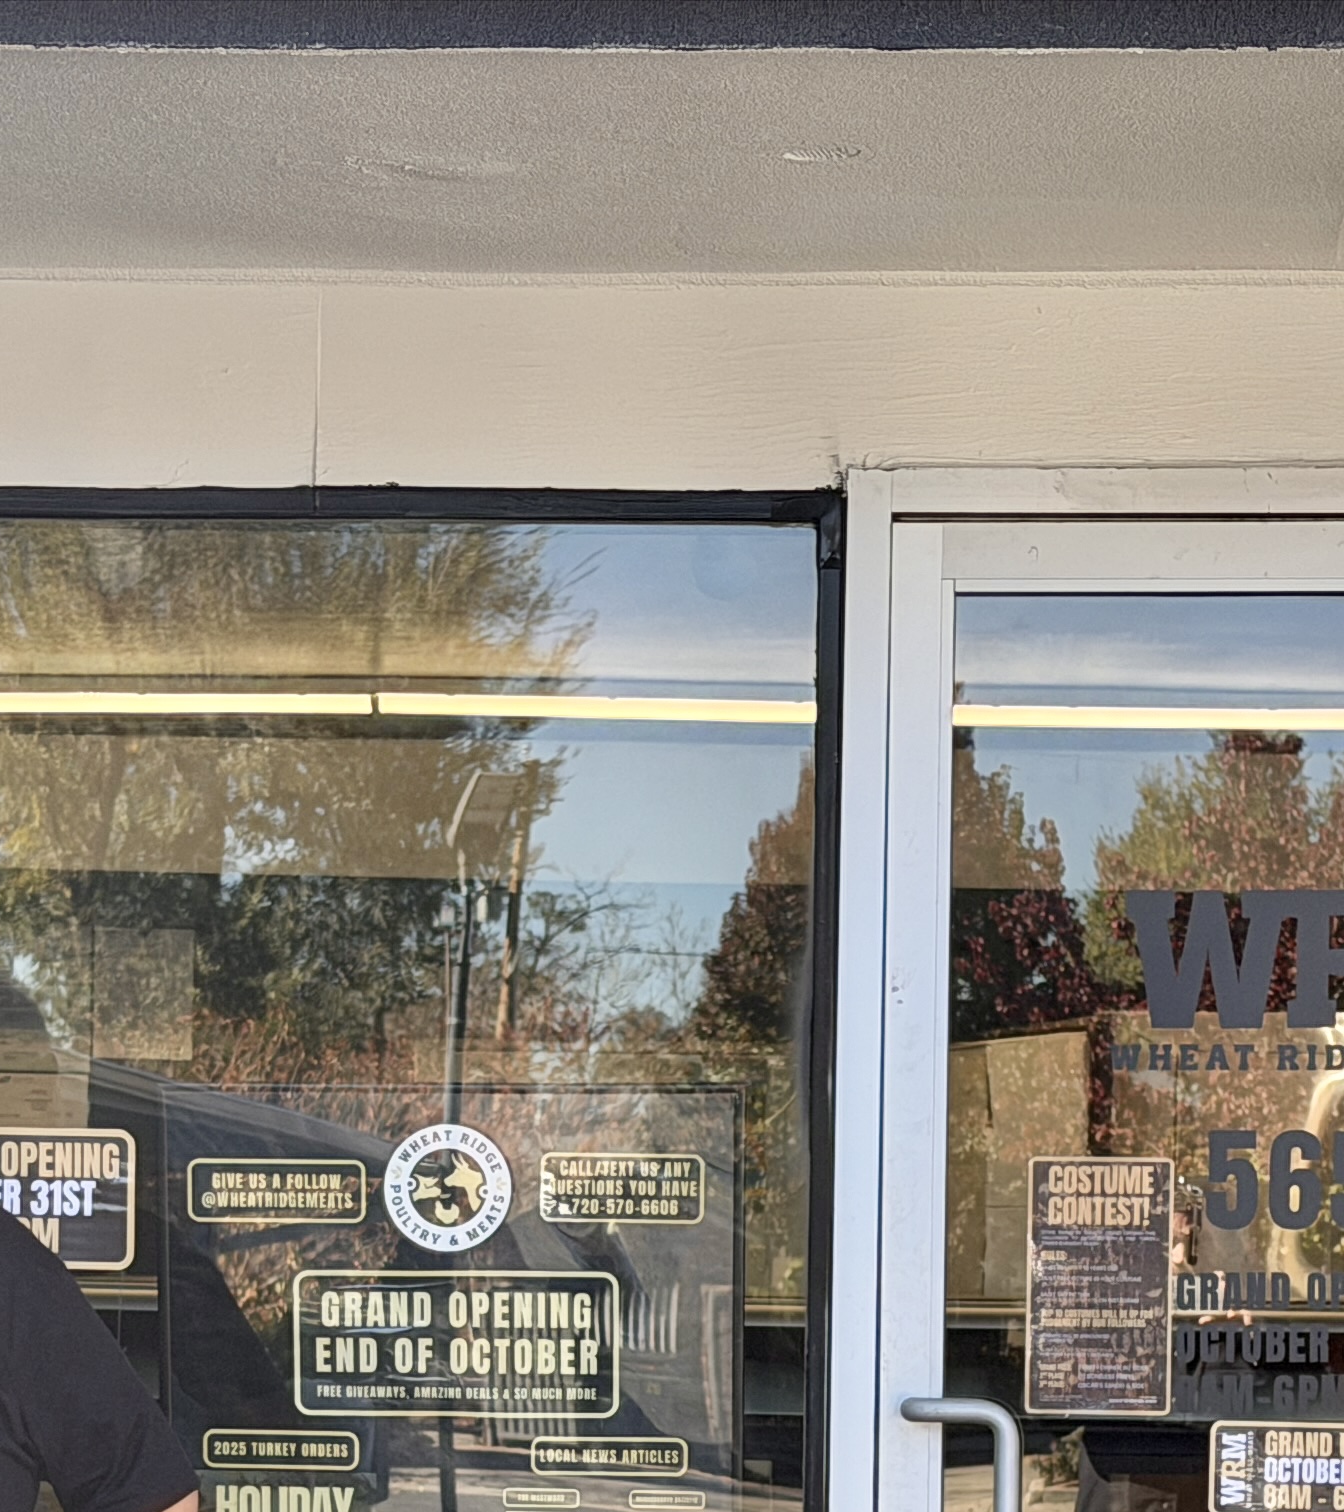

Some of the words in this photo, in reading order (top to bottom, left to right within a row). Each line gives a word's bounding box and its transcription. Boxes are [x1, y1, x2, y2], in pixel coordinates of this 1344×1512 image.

[1111, 1044, 1255, 1071] WHEAT
[0, 1141, 121, 1179] OPENING
[398, 1130, 452, 1163] WHEAT
[459, 1132, 502, 1173] RIDGE
[211, 1172, 244, 1189] GIVE
[248, 1173, 267, 1189] US
[272, 1173, 281, 1190] A
[286, 1173, 342, 1190] FOLLOW
[559, 1160, 635, 1177] CALL/TEXT
[639, 1161, 659, 1178] US
[663, 1162, 691, 1178] ANY
[1048, 1165, 1155, 1195] COSTUME
[29, 1180, 97, 1216] 31ST
[201, 1191, 354, 1209] @WHEATRIDGEMEATS
[629, 1180, 657, 1196] YOU
[661, 1180, 698, 1197] HAVE
[390, 1184, 442, 1245] POULTRY
[465, 1194, 505, 1241] MEATS
[571, 1198, 679, 1216] 720-570-6606
[1047, 1196, 1151, 1227] CONTEST!
[1176, 1272, 1291, 1311] GRAND
[320, 1291, 432, 1328] GRAND
[448, 1291, 592, 1329] OPENING
[315, 1337, 378, 1374] END
[394, 1337, 433, 1374] OF
[449, 1338, 598, 1375] OCTOBER
[1176, 1322, 1329, 1364] OCTOBER
[317, 1385, 342, 1398] FREE
[413, 1386, 462, 1399] AMAZING
[465, 1387, 499, 1400] DEALS
[514, 1387, 528, 1400] SO
[531, 1387, 562, 1400] MUCH
[566, 1387, 597, 1400] MORE
[213, 1441, 247, 1456] 2025
[251, 1442, 297, 1457] TURKEY
[301, 1443, 349, 1458] ORDERS
[539, 1448, 578, 1463] LOCAL
[582, 1449, 617, 1463] NEWS
[622, 1449, 679, 1464] ARTICLES
[1264, 1430, 1333, 1457] GRAND
[1220, 1433, 1247, 1505] WRM
[1263, 1484, 1312, 1511] 8AM
